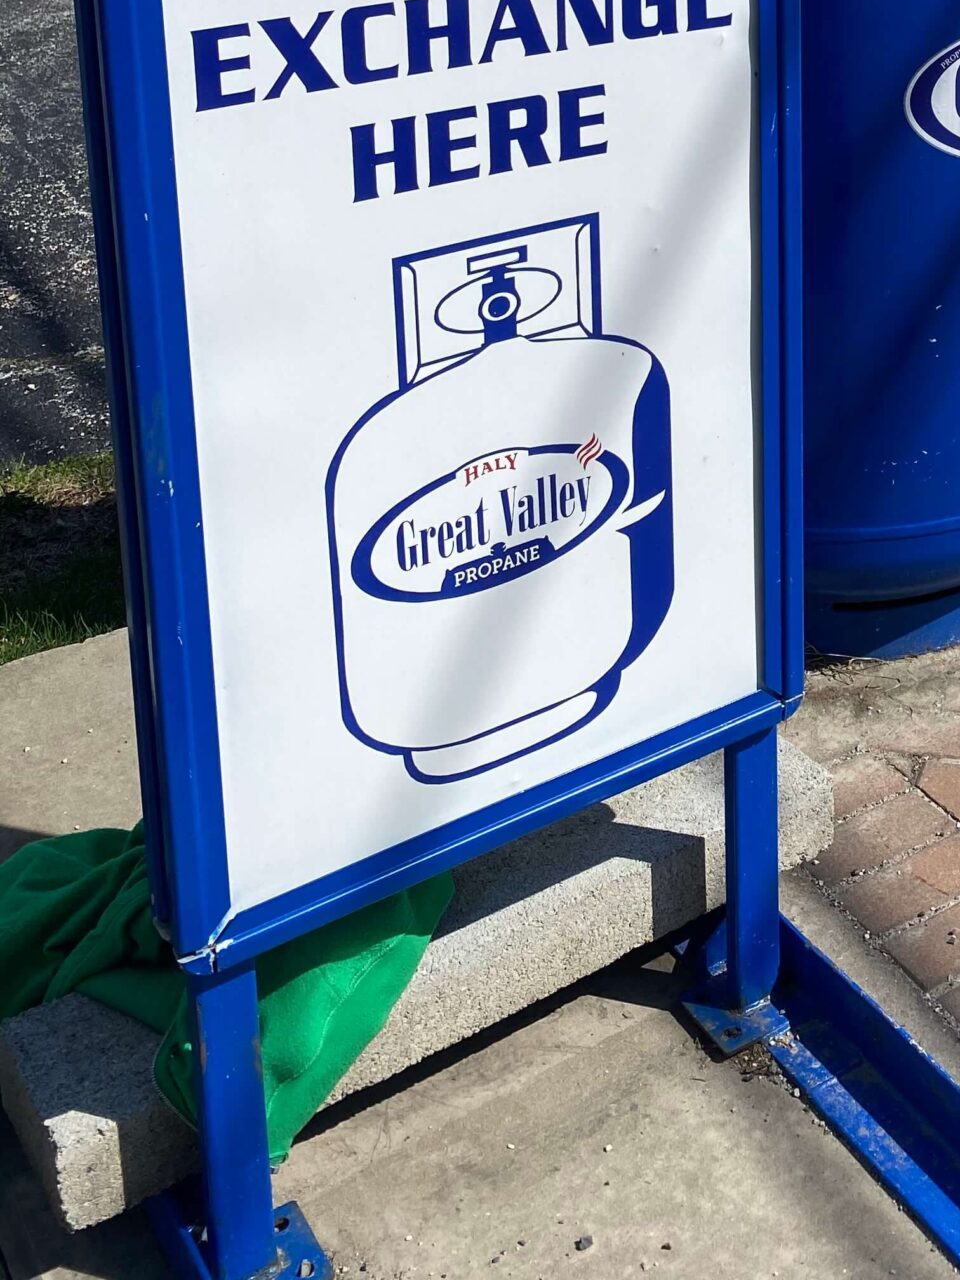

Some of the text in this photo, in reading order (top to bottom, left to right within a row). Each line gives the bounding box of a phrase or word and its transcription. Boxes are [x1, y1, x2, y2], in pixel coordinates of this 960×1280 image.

[350, 84, 609, 204] HERE
[464, 453, 518, 487] HALY
[396, 473, 591, 572] Great Valley
[454, 545, 540, 587] PROPANE
